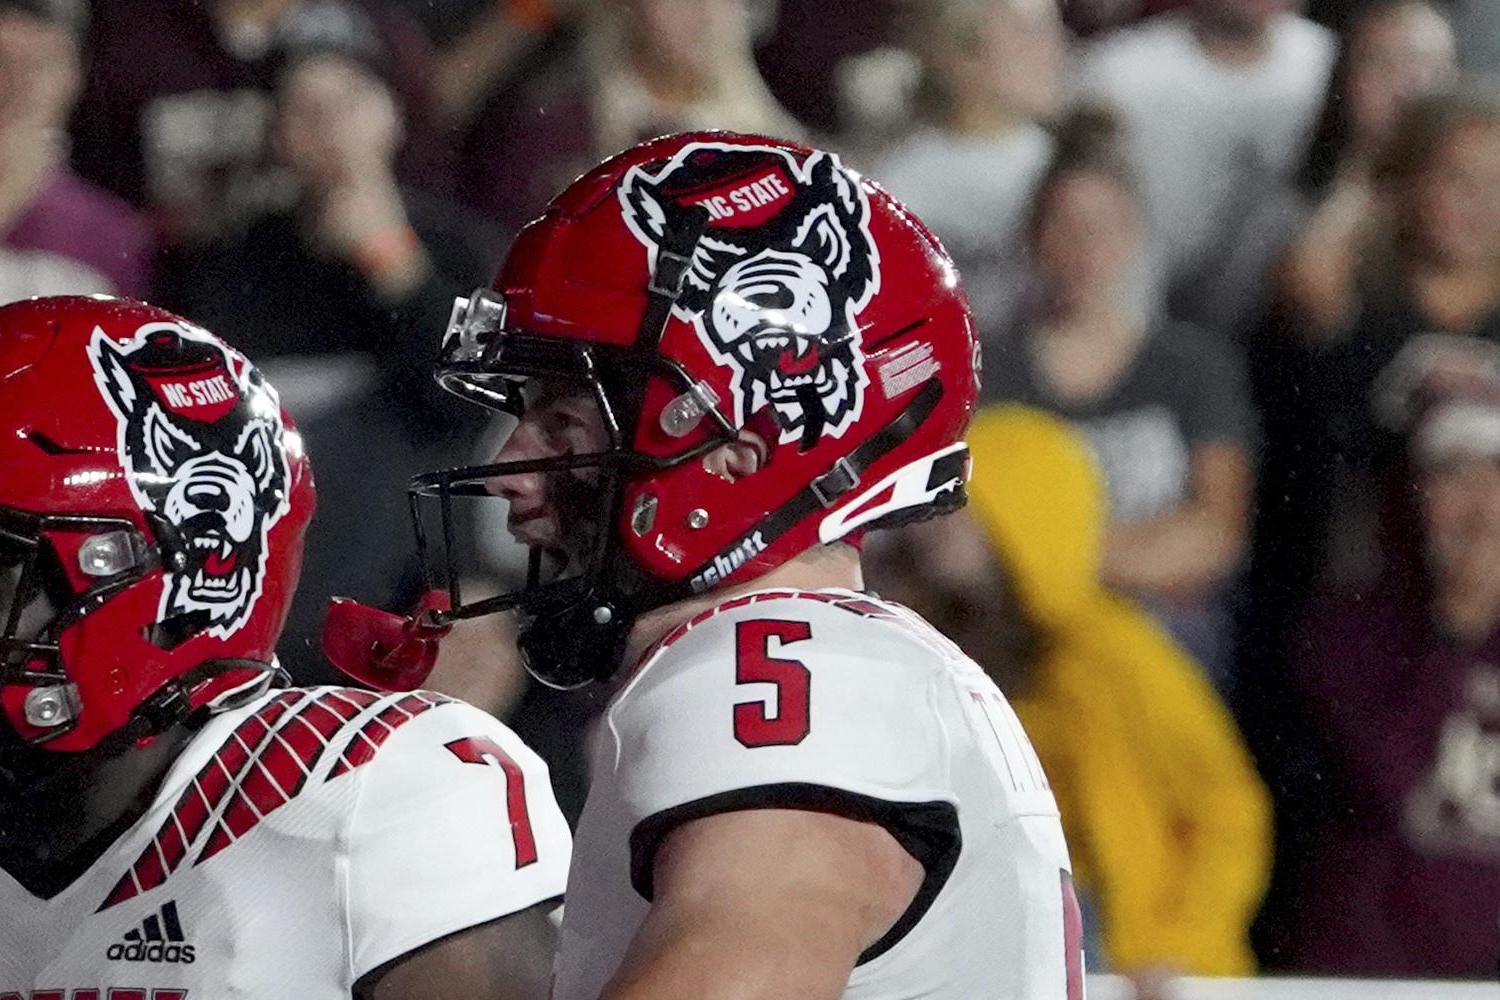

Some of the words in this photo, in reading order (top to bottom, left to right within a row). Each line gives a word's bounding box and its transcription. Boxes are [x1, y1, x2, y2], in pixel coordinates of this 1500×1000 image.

[728, 172, 790, 212] STATE
[160, 382, 194, 408] NC
[188, 374, 235, 405] STATE
[732, 617, 813, 749] 5
[443, 735, 539, 871] 7
[106, 937, 197, 965] adidas
